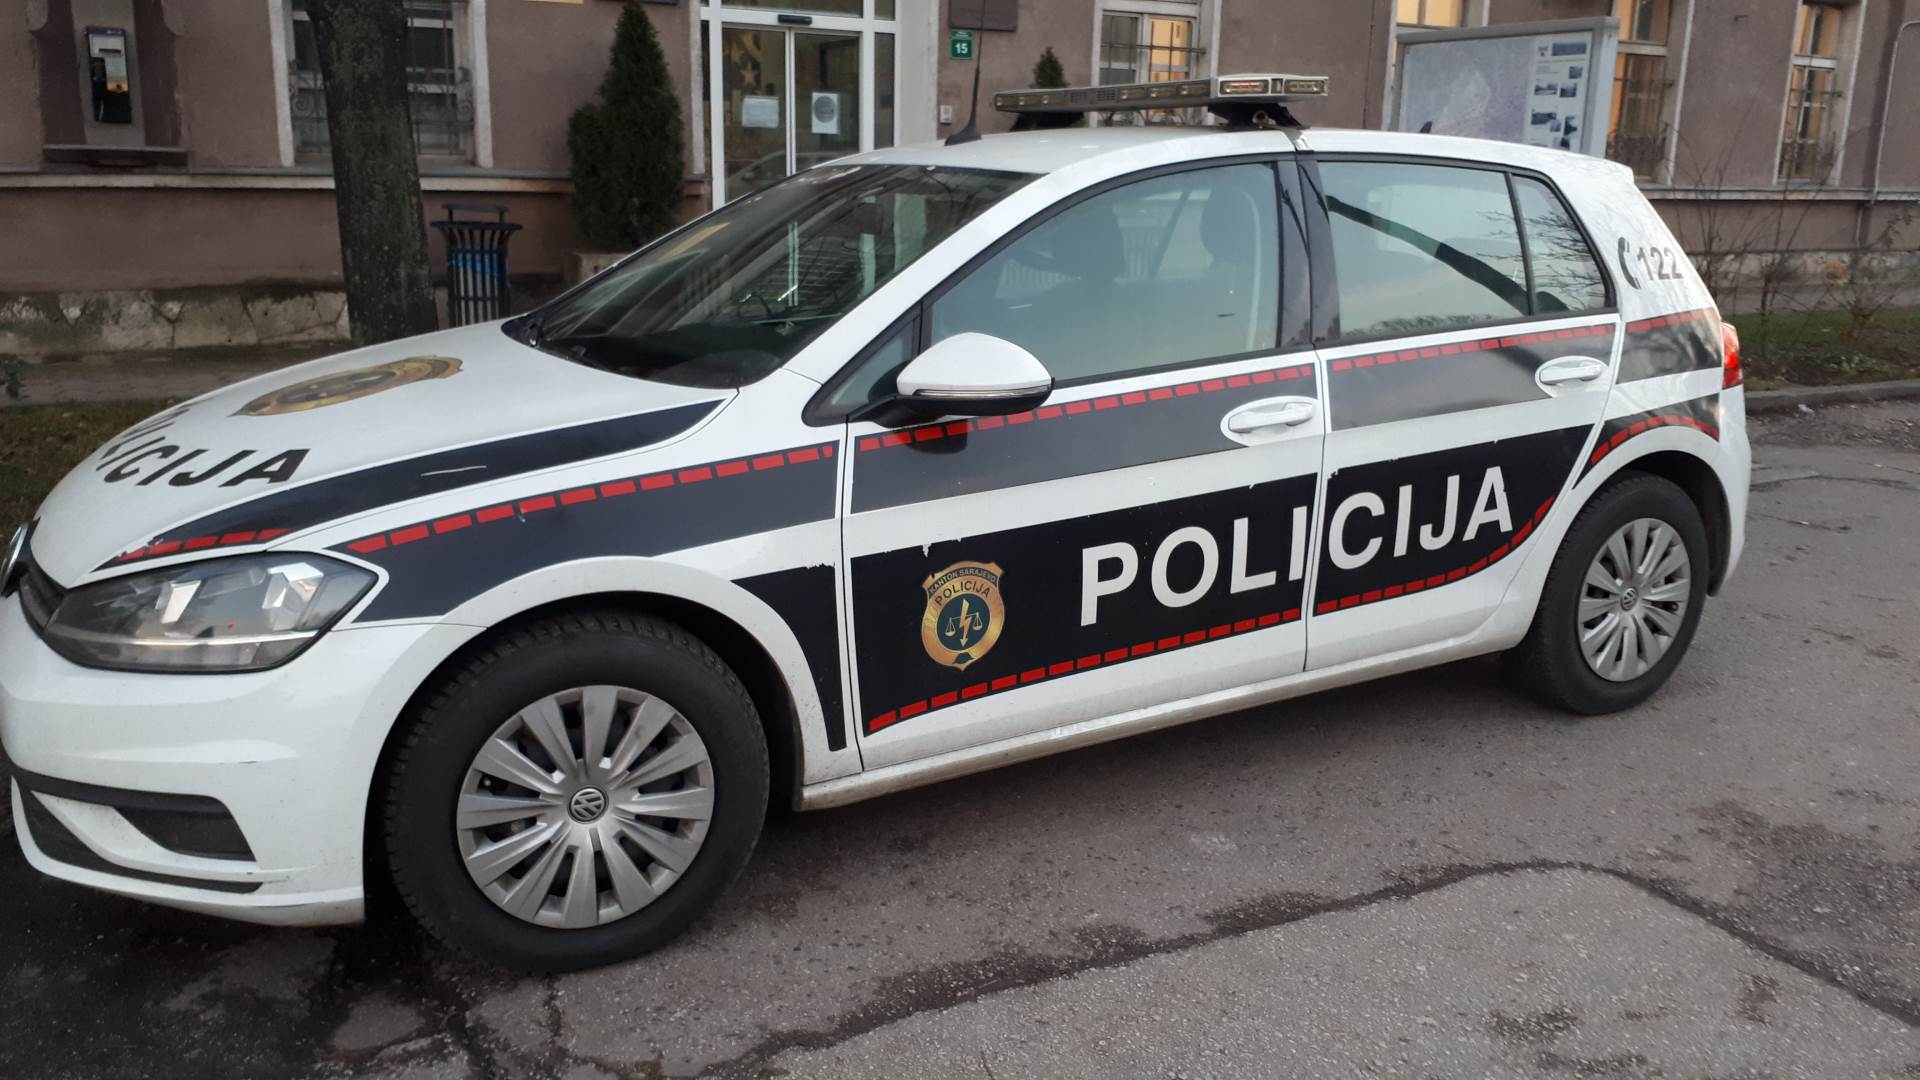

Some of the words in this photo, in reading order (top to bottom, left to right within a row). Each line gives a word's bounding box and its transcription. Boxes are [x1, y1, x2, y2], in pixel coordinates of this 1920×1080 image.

[955, 42, 969, 54] 15
[1637, 246, 1684, 281] 122
[1080, 466, 1513, 627] POLICIJA
[934, 580, 991, 606] POLICIJA
